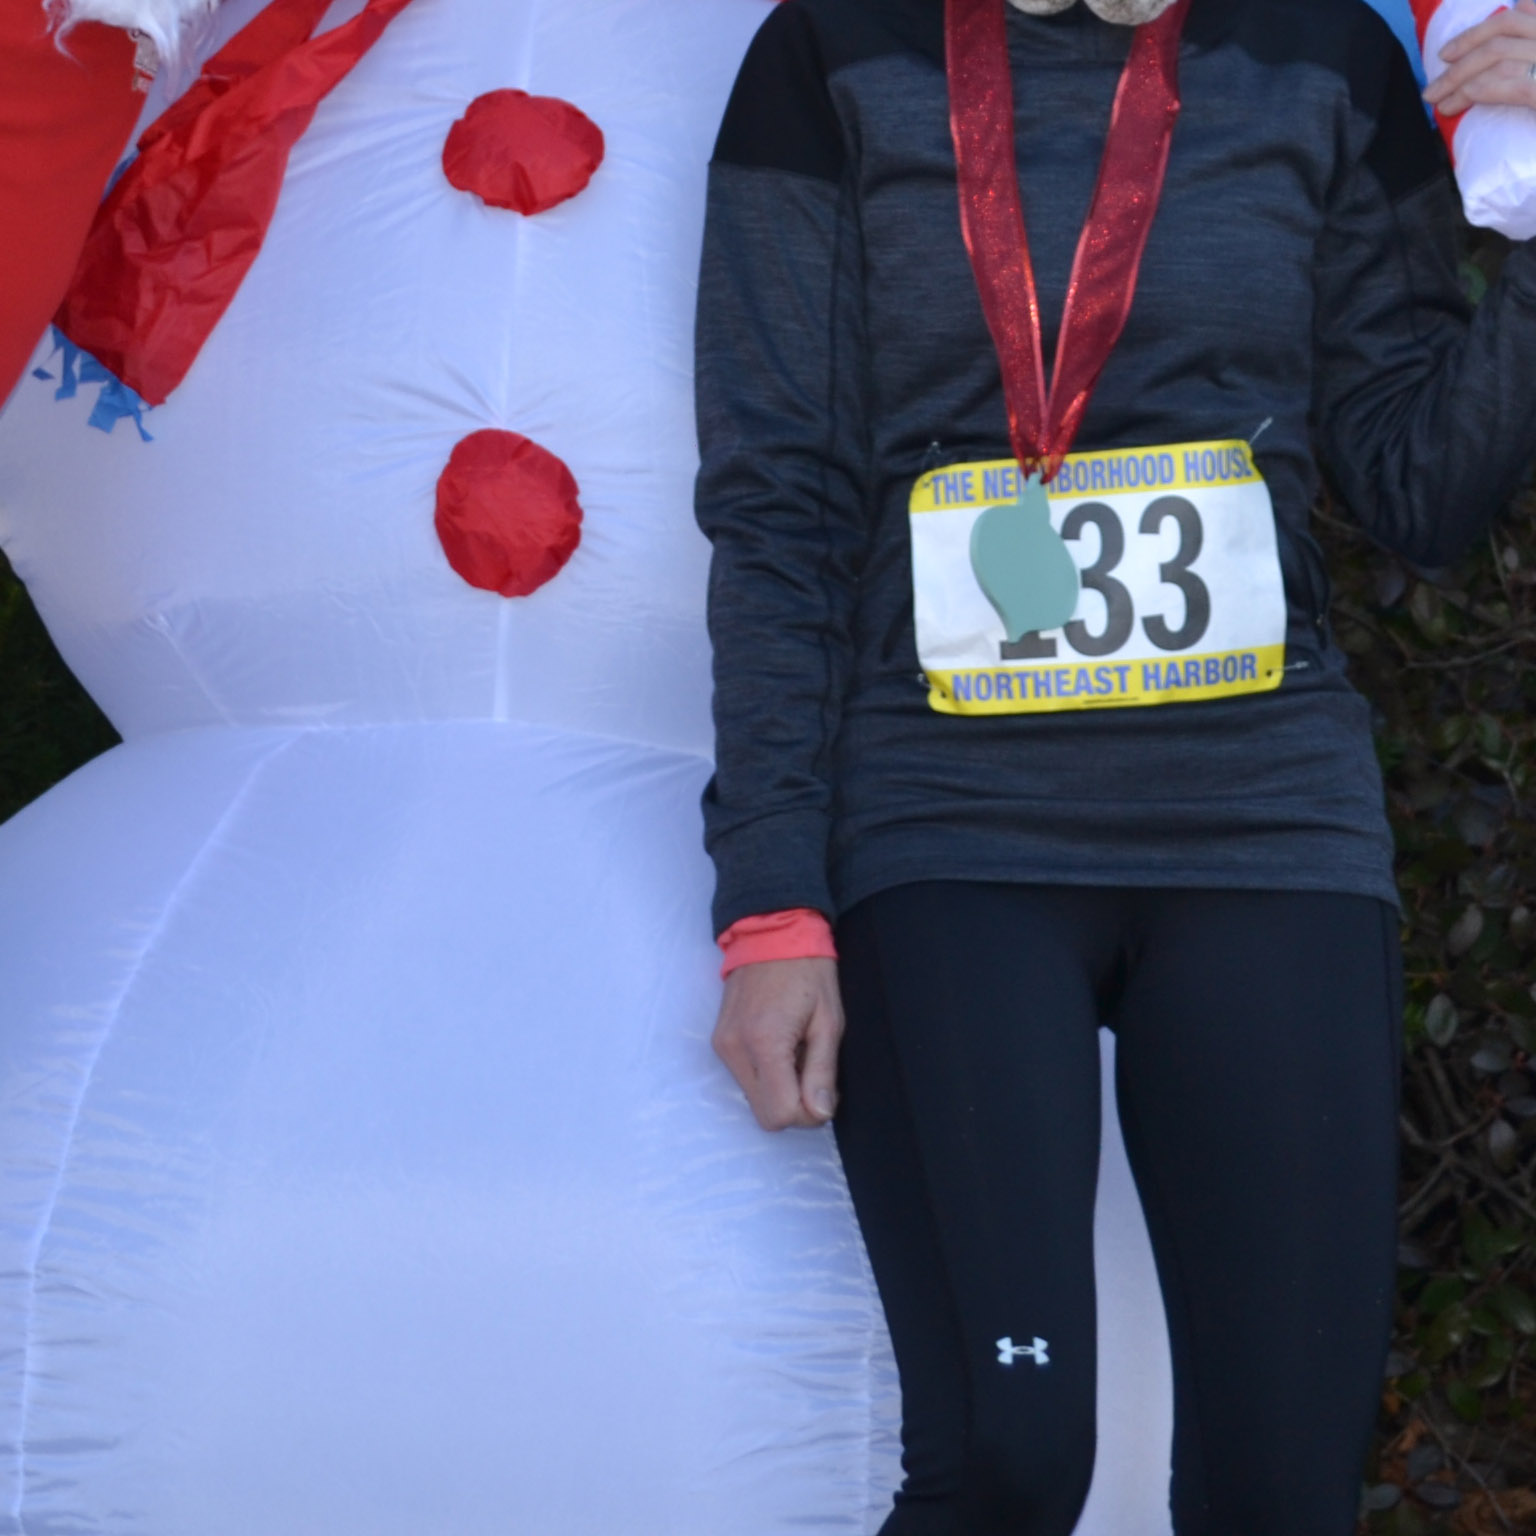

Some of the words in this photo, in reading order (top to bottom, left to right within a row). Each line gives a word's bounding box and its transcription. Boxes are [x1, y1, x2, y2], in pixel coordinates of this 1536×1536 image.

[931, 470, 976, 506] THE
[982, 452, 1175, 500] NEIBORHOOD
[1184, 447, 1253, 483] HOUS
[999, 495, 1212, 661] 33
[951, 665, 1131, 702] NORTHEAST
[1142, 653, 1257, 692] HARBOR
